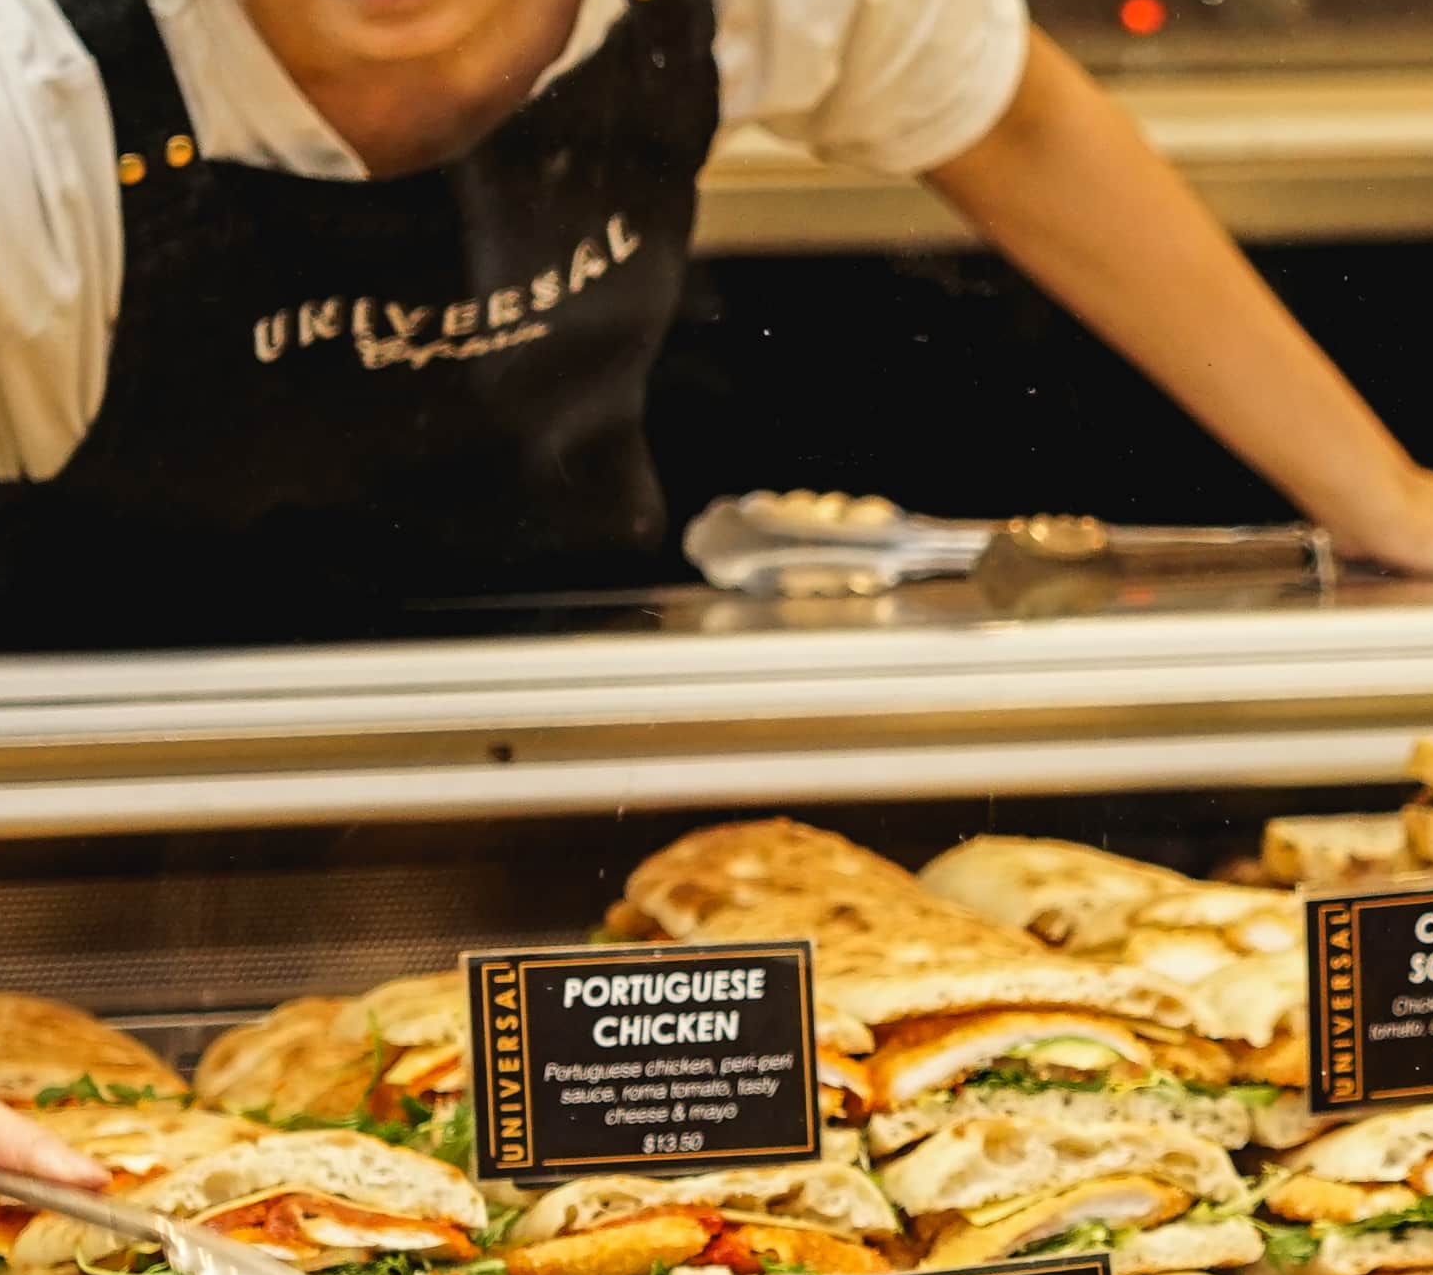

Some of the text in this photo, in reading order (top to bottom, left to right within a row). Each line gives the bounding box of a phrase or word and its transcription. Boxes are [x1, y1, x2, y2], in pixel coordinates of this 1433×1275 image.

[253, 212, 643, 364] UNIVERSAL
[562, 967, 766, 1008] PORTUGUESE
[1328, 909, 1354, 1097] UNIVERSAL
[592, 1010, 740, 1048] CHICKEN
[494, 967, 525, 1162] UNIVERSAL
[544, 1061, 643, 1084] Portuguese
[645, 1058, 715, 1079] chicken,
[560, 1076, 780, 1105] sauce, roma tomato, tasty
[604, 1101, 738, 1126] cheese & mayo
[642, 1130, 705, 1155] $13.50
